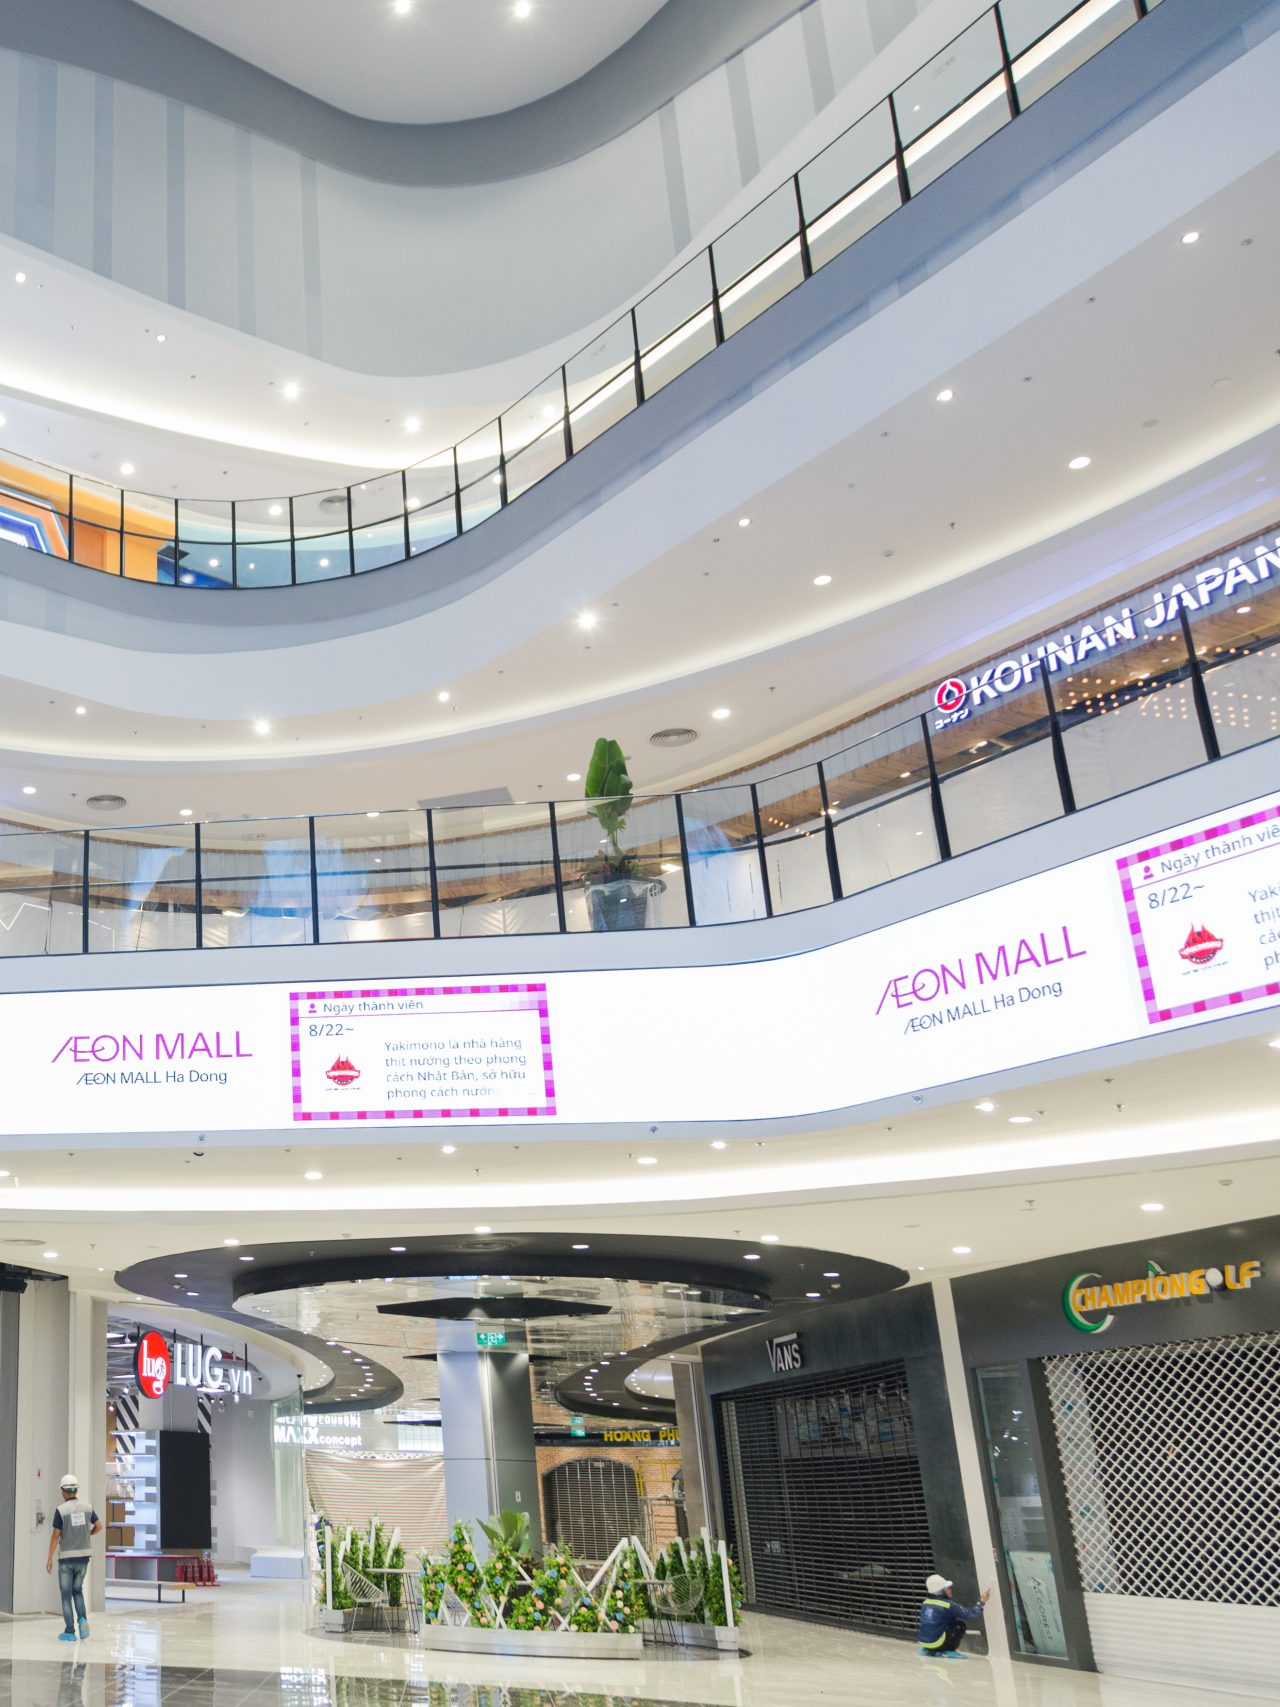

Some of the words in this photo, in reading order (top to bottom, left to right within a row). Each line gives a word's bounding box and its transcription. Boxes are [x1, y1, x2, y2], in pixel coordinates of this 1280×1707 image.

[971, 606, 1136, 705] KOHNAN
[1159, 850, 1202, 876] Ngày
[1204, 834, 1254, 860] thành
[974, 924, 1088, 986] MALL
[322, 1002, 355, 1016] Ngày
[357, 1000, 395, 1013] thành
[397, 998, 424, 1011] viên
[946, 998, 992, 1024] MALL
[993, 991, 1016, 1011] Ha
[1018, 980, 1064, 1004] Dong
[155, 1030, 254, 1061] MALL
[384, 1040, 446, 1052] Yakimono
[453, 1054, 482, 1066] theo
[485, 1053, 527, 1067] phong
[120, 1070, 162, 1085] MALL
[165, 1070, 185, 1084] Ha
[188, 1069, 228, 1085] Dong
[386, 1071, 414, 1083] cách
[387, 1087, 427, 1101] phong
[430, 1086, 458, 1098] cách
[141, 1339, 168, 1396] lug
[765, 1332, 802, 1373] VANS
